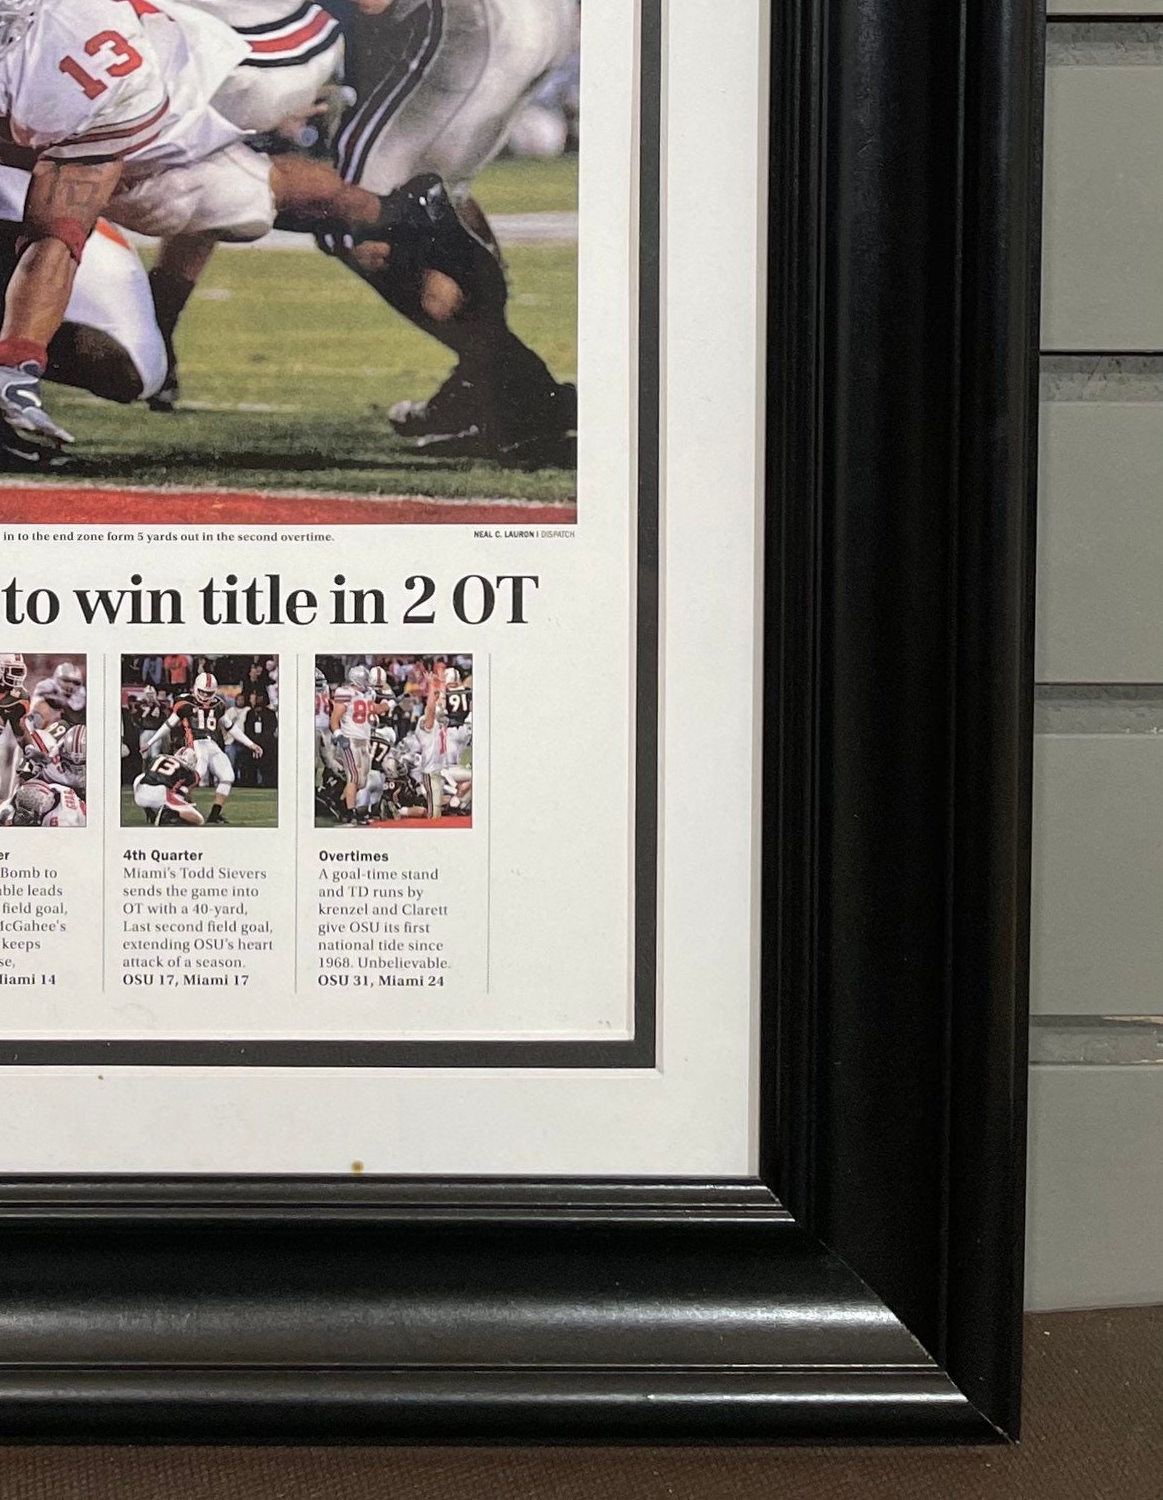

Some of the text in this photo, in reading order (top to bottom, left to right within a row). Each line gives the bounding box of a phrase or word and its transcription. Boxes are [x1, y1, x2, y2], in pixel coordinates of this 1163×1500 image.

[58, 30, 143, 101] 13
[2, 531, 15, 542] in
[17, 532, 30, 542] to
[31, 530, 51, 542] the
[52, 530, 75, 542] end
[76, 533, 105, 542] zone
[106, 530, 135, 542] form
[136, 531, 145, 542] 5
[146, 531, 179, 545] yards
[180, 532, 200, 542] out
[201, 531, 214, 542] in
[216, 531, 236, 542] the
[237, 531, 279, 542] second
[280, 531, 336, 542] overtime.
[473, 529, 494, 539] NEAL
[503, 530, 535, 539] LAURON
[540, 529, 576, 539] DISPATCH
[1, 577, 60, 624] to
[73, 574, 185, 624] win
[199, 574, 317, 625] title
[330, 574, 388, 624] in
[403, 575, 435, 624] 2
[453, 575, 539, 625] OT
[448, 693, 469, 712] 91
[150, 754, 180, 776] 13
[122, 848, 204, 864] 4th Quarter
[318, 849, 390, 863] Overtimes
[0, 865, 41, 879] Bomb
[44, 868, 58, 879] to
[122, 865, 267, 880] Miami's Todd Sievers
[318, 867, 439, 884] A goal-time stand
[318, 884, 424, 902] and TD runs by
[122, 937, 274, 954] extending OSU's heart
[318, 938, 375, 951] national
[407, 939, 444, 952] since
[122, 955, 246, 969] attack of a season.
[357, 955, 452, 970] Unbelievable.
[41, 973, 56, 986] 14
[122, 973, 250, 988] OSU 17, Miami 17
[317, 973, 445, 989] OSU 31, Miami 24
